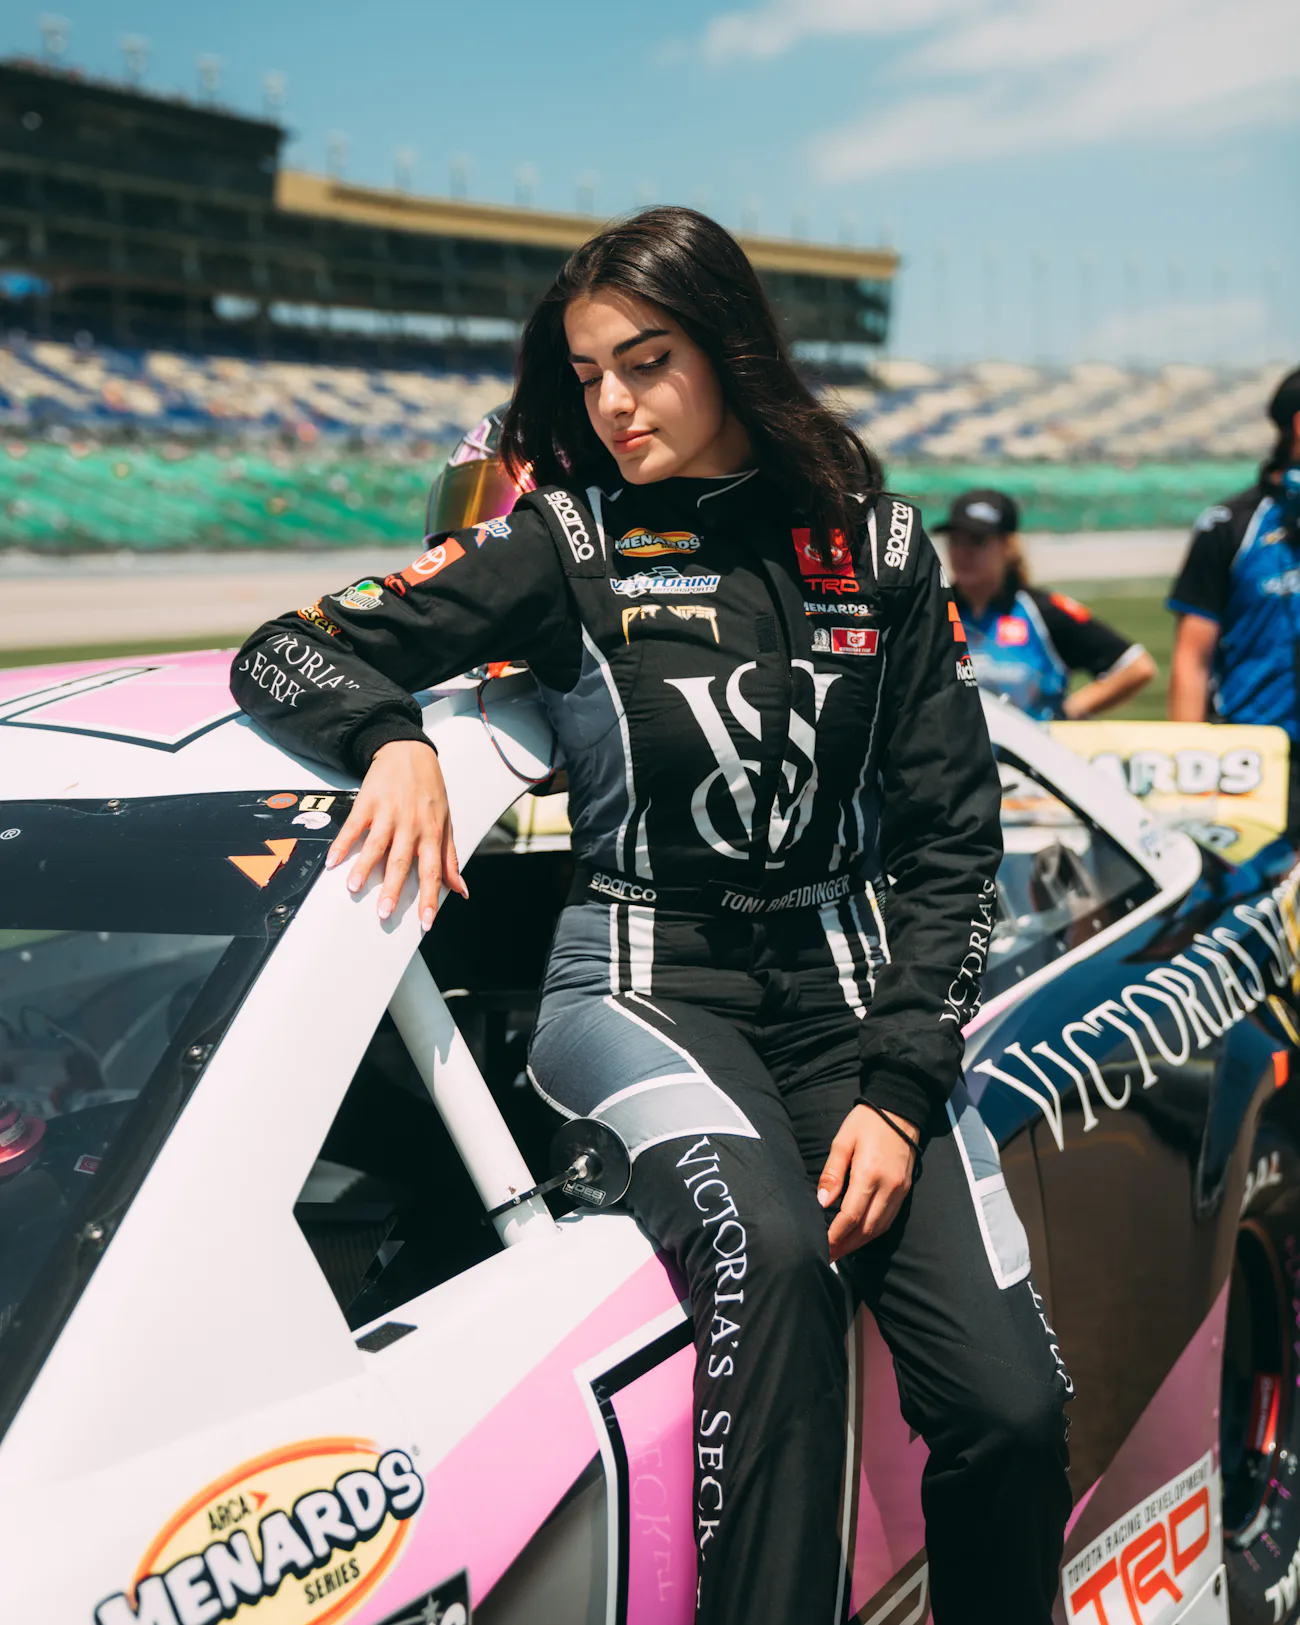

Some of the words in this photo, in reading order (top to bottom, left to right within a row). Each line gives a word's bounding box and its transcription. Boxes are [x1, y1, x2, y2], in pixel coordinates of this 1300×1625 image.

[545, 490, 595, 563] sparco
[884, 501, 913, 570] sparco
[804, 578, 860, 595] TRD
[300, 605, 342, 637] ese's
[588, 871, 658, 901] sparco
[720, 889, 765, 914] TONI
[765, 873, 851, 913] BREIDINGER
[676, 1135, 748, 1379] VICTORIA'S
[95, 1448, 425, 1625] MENARDS
[208, 1495, 253, 1533] ARCA
[1067, 1546, 1103, 1588] TOYOTA
[1105, 1512, 1142, 1555] RACING
[1144, 1460, 1210, 1523] DEVELOPMENT
[304, 1557, 361, 1605] SERIES
[1070, 1485, 1211, 1625] TRD
